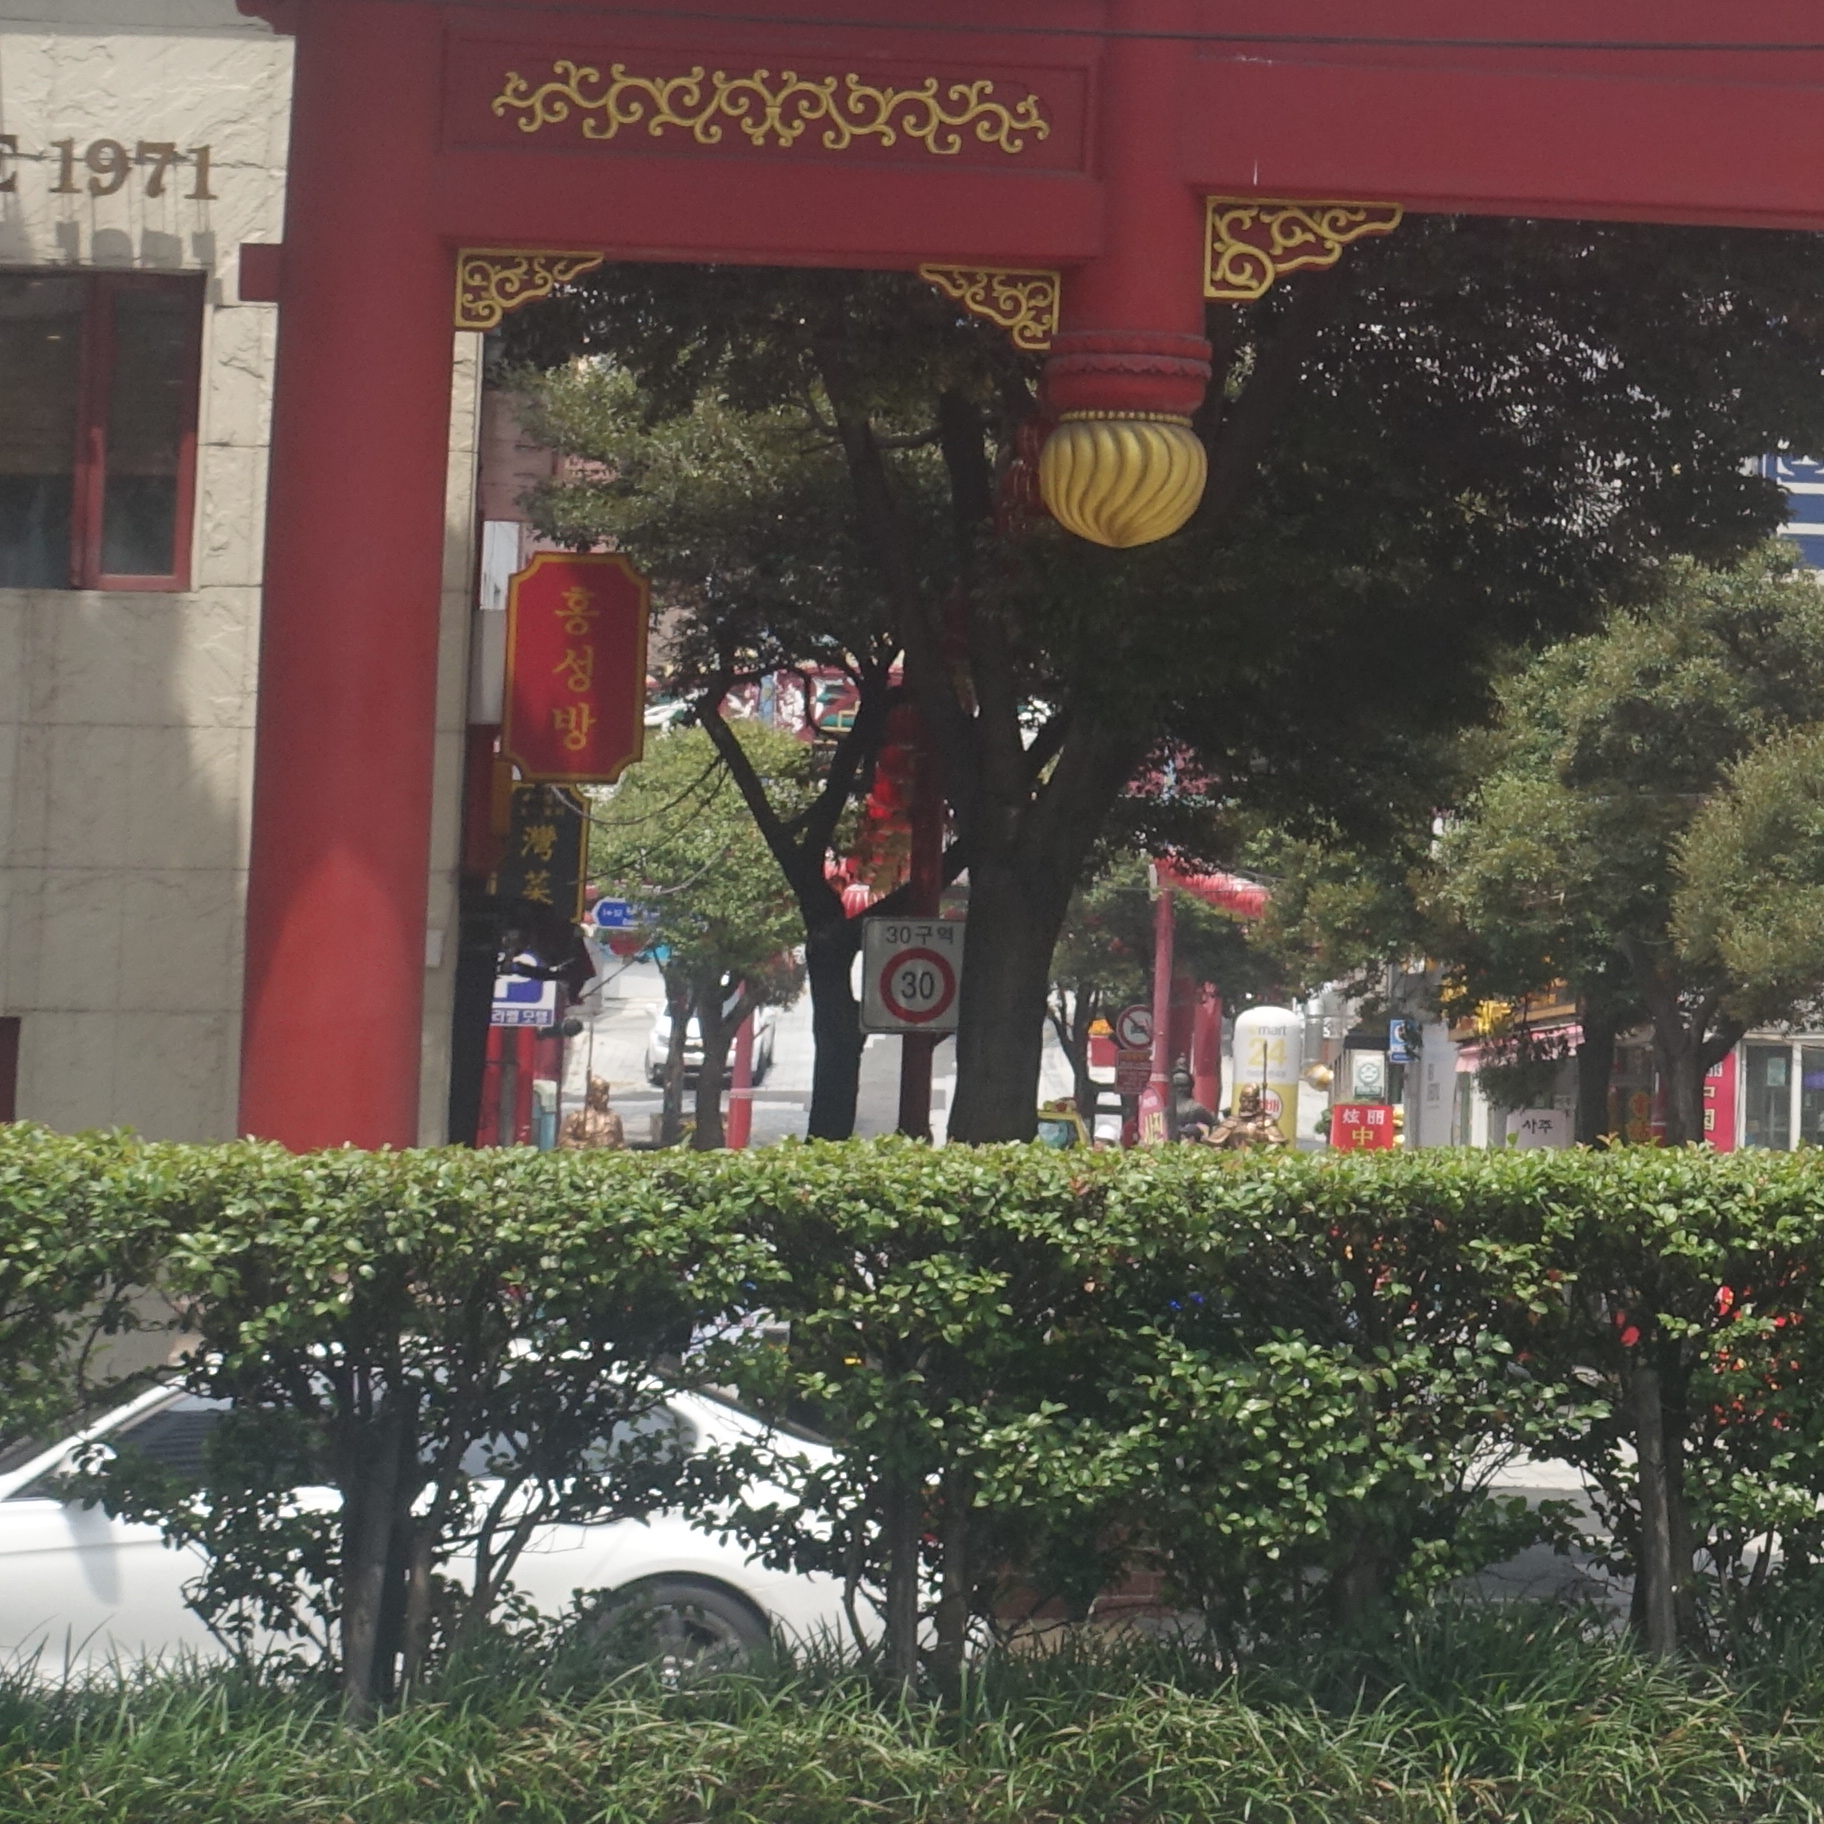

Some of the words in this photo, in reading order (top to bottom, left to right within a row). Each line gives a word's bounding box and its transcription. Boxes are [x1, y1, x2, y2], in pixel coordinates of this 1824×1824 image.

[48, 137, 219, 201] 1971
[553, 586, 600, 751] 홍성방
[886, 925, 954, 945] 30구역
[901, 971, 934, 1000] 30
[1522, 1117, 1554, 1135] 사주
